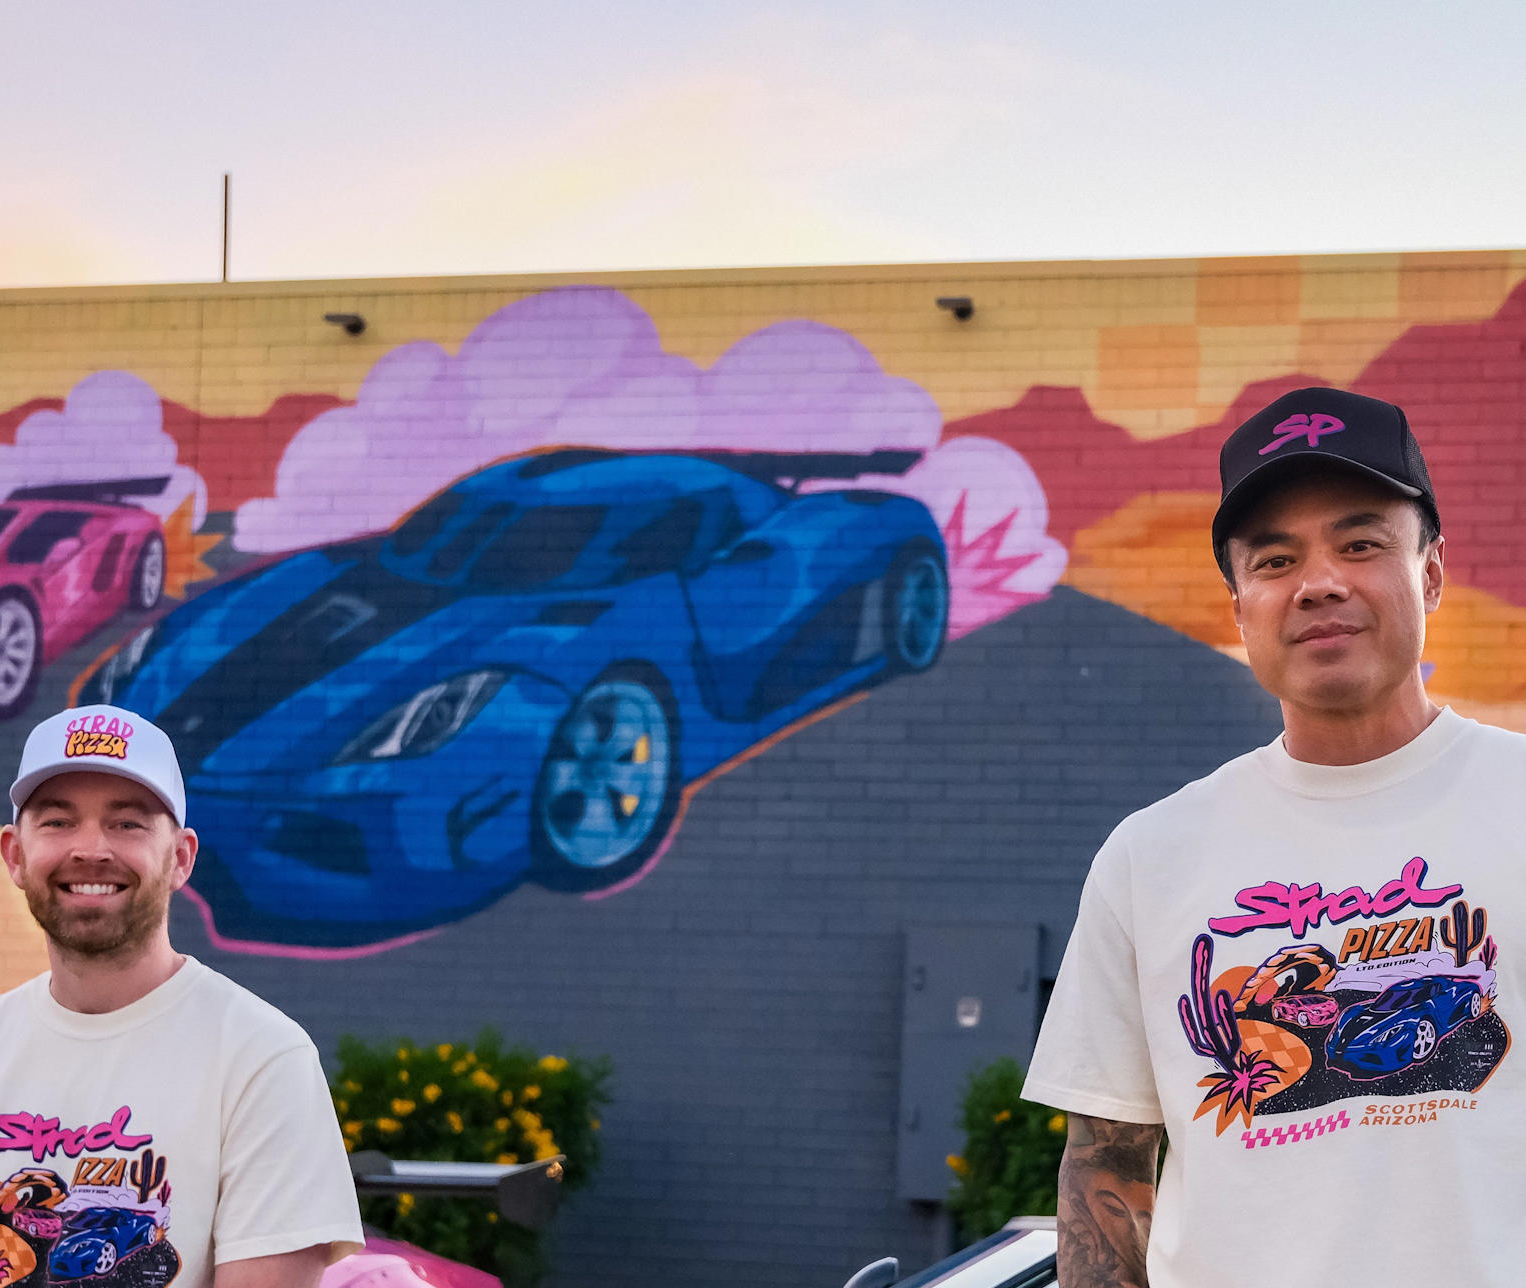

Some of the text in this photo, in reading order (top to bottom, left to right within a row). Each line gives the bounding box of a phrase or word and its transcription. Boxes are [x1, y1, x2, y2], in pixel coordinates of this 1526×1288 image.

[1258, 413, 1346, 456] SP
[65, 714, 134, 739] STRAD
[1208, 857, 1463, 938] Strad
[1337, 915, 1435, 964] PIZZA
[1358, 1111, 1438, 1127] ARIZONA
[1364, 1098, 1478, 1115] SCOTTSDALE
[70, 1157, 128, 1188] IZZA
